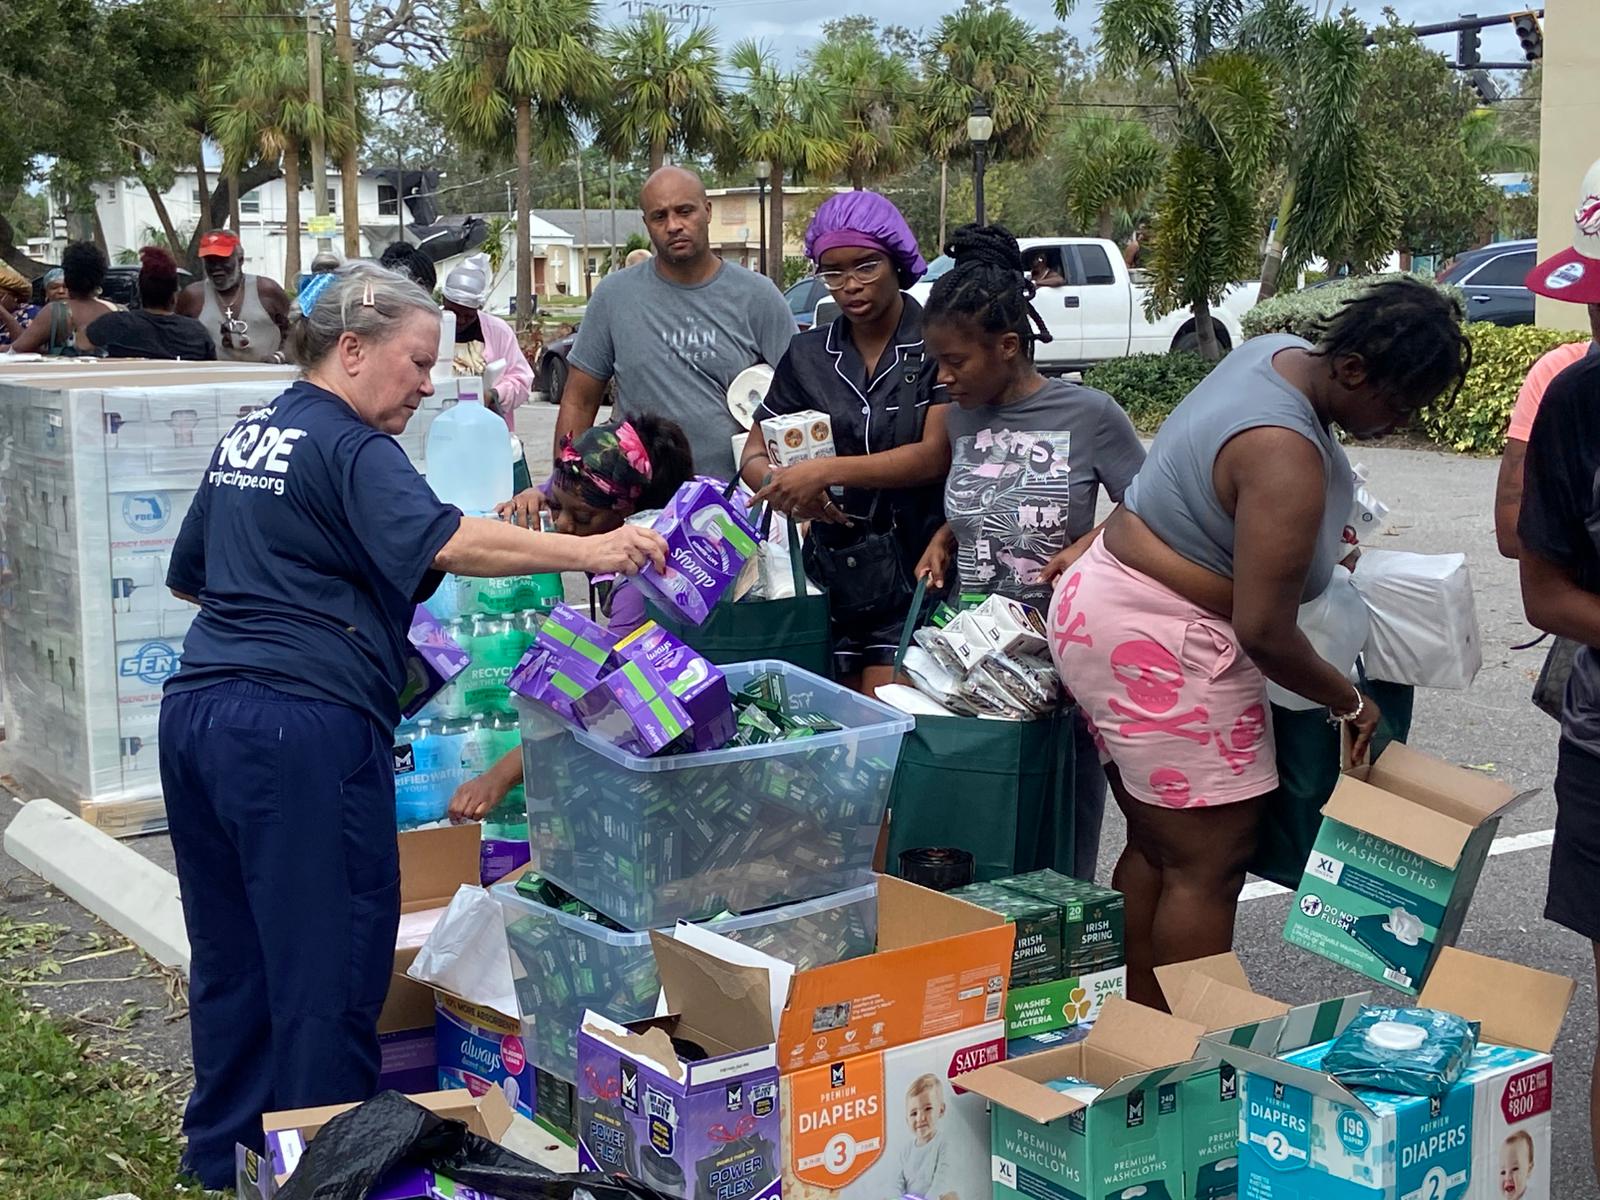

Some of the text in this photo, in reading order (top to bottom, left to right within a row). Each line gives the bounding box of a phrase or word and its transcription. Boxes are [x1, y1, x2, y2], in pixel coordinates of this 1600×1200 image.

[672, 547, 716, 589] always
[1356, 831, 1424, 870] PREMIUM
[1317, 857, 1335, 874] XL
[1335, 838, 1437, 889] WASHCLOTHS
[1069, 906, 1082, 915] 20
[1324, 904, 1359, 924] DO NOT
[1086, 920, 1110, 933] IRISH
[1320, 913, 1350, 931] FLUSH
[1018, 934, 1043, 948] IRISH
[1081, 930, 1113, 944] SPRING
[1014, 944, 1047, 960] SPRING
[1094, 976, 1123, 992] SAVE
[1014, 997, 1051, 1012] WASHES
[1019, 1007, 1046, 1019] AWAY
[1010, 1015, 1053, 1030] BACTERIA
[460, 1037, 500, 1073] always
[956, 1047, 987, 1071] SAVE
[820, 1086, 857, 1103] PREMIUM
[1508, 1073, 1537, 1099] SAVE
[1265, 1096, 1291, 1111] PREMIUM
[1508, 1094, 1534, 1117] $800
[799, 1095, 879, 1134] DIAPERS
[1250, 1102, 1307, 1133] DIAPERS
[1420, 1116, 1449, 1133] PREMIUM
[1343, 1116, 1364, 1138] 196
[833, 1141, 847, 1166] 3
[1016, 1128, 1067, 1161] PREMIUM
[1272, 1137, 1283, 1155] 2
[1402, 1124, 1466, 1169] DIAPERS
[999, 1162, 1012, 1178] XL
[1004, 1138, 1080, 1182] WASHCLOTHS
[1113, 1153, 1156, 1172] PREMIUM
[709, 1156, 764, 1188] POWER
[1103, 1160, 1167, 1185] WASHCLOTHS
[718, 1174, 756, 1200] FLEX
[1428, 1174, 1440, 1200] 2
